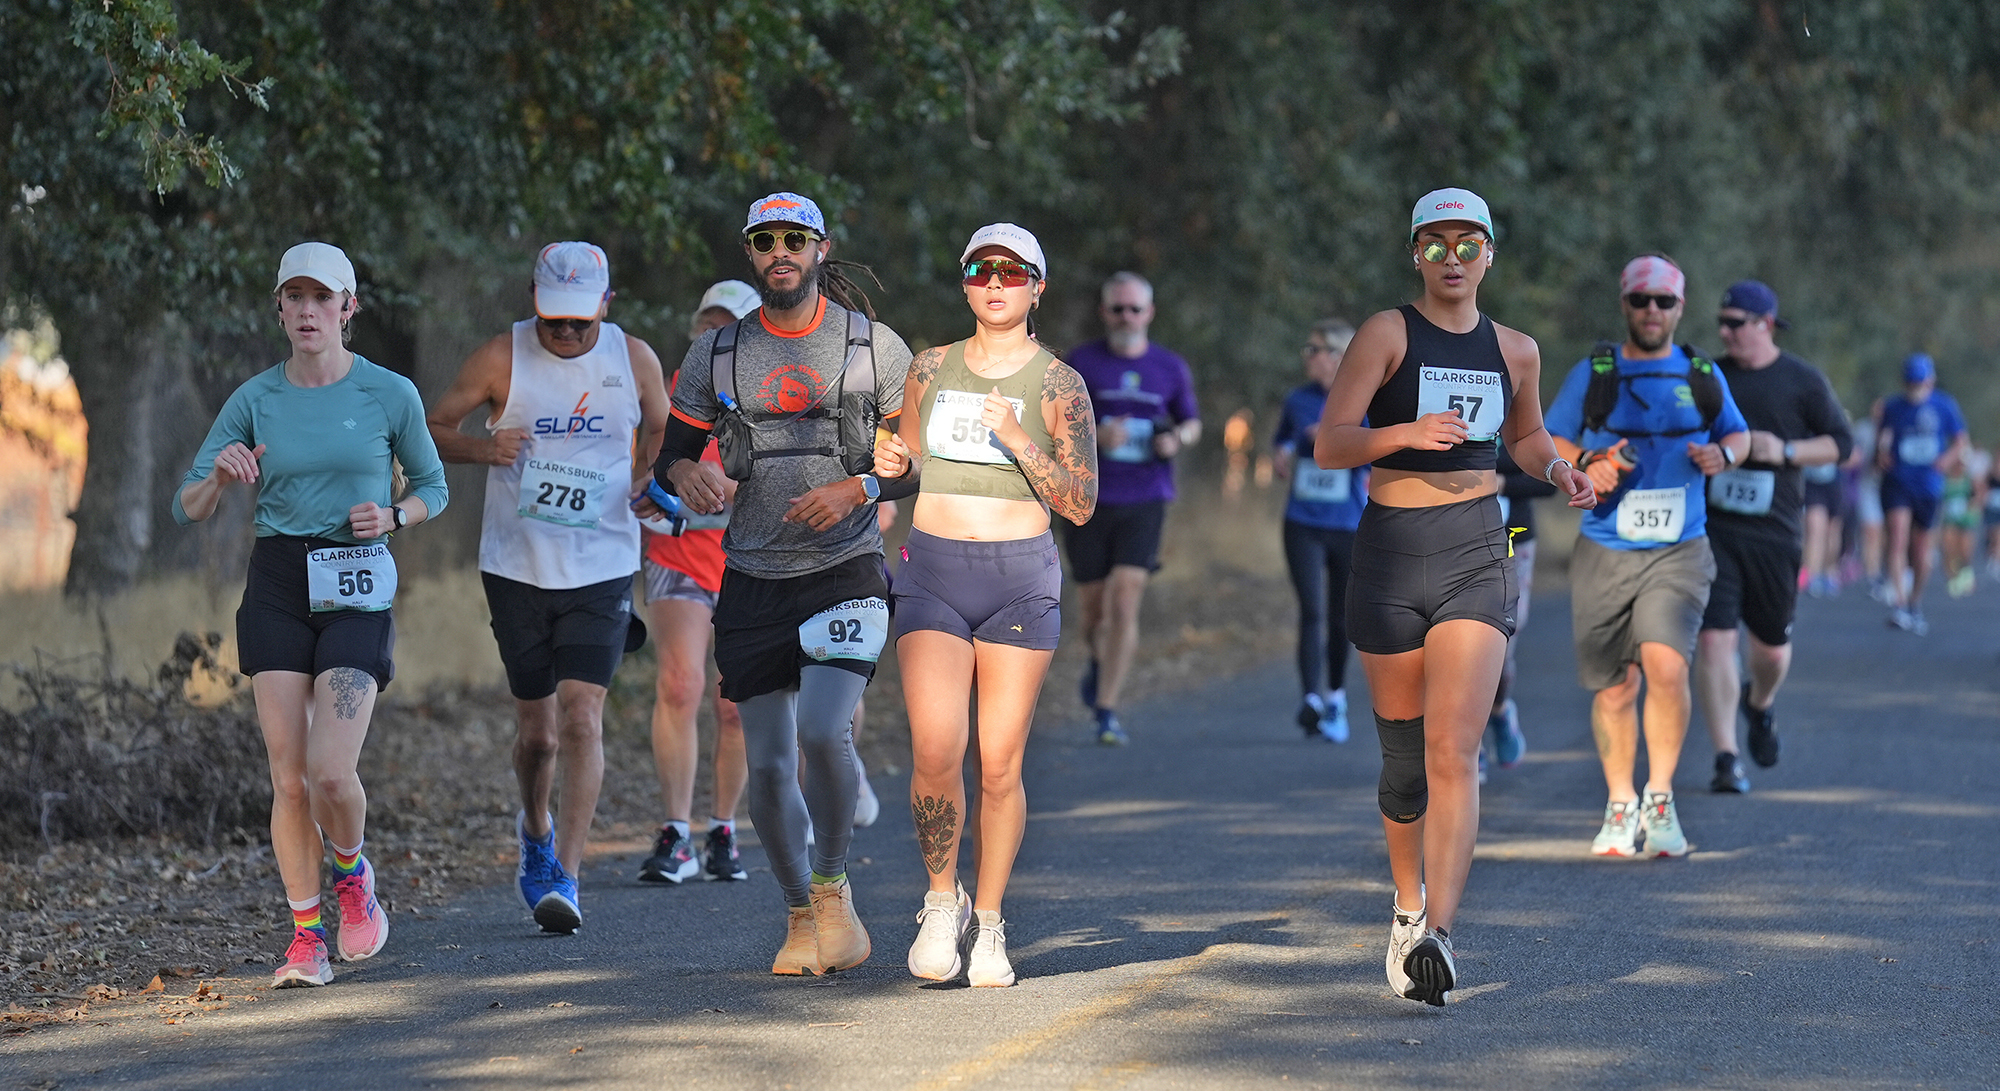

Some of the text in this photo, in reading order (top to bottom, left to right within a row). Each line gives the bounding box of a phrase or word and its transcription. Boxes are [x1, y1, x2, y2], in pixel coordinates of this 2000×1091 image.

[1435, 201, 1465, 210] ciele
[937, 393, 1018, 411] CLARKSG
[1448, 395, 1483, 423] 57
[534, 416, 604, 434] SLDC
[529, 460, 605, 482] CLARKSBURG
[536, 481, 587, 512] 278
[1634, 509, 1672, 527] 357
[338, 569, 374, 597] 56
[828, 619, 863, 643] 92
